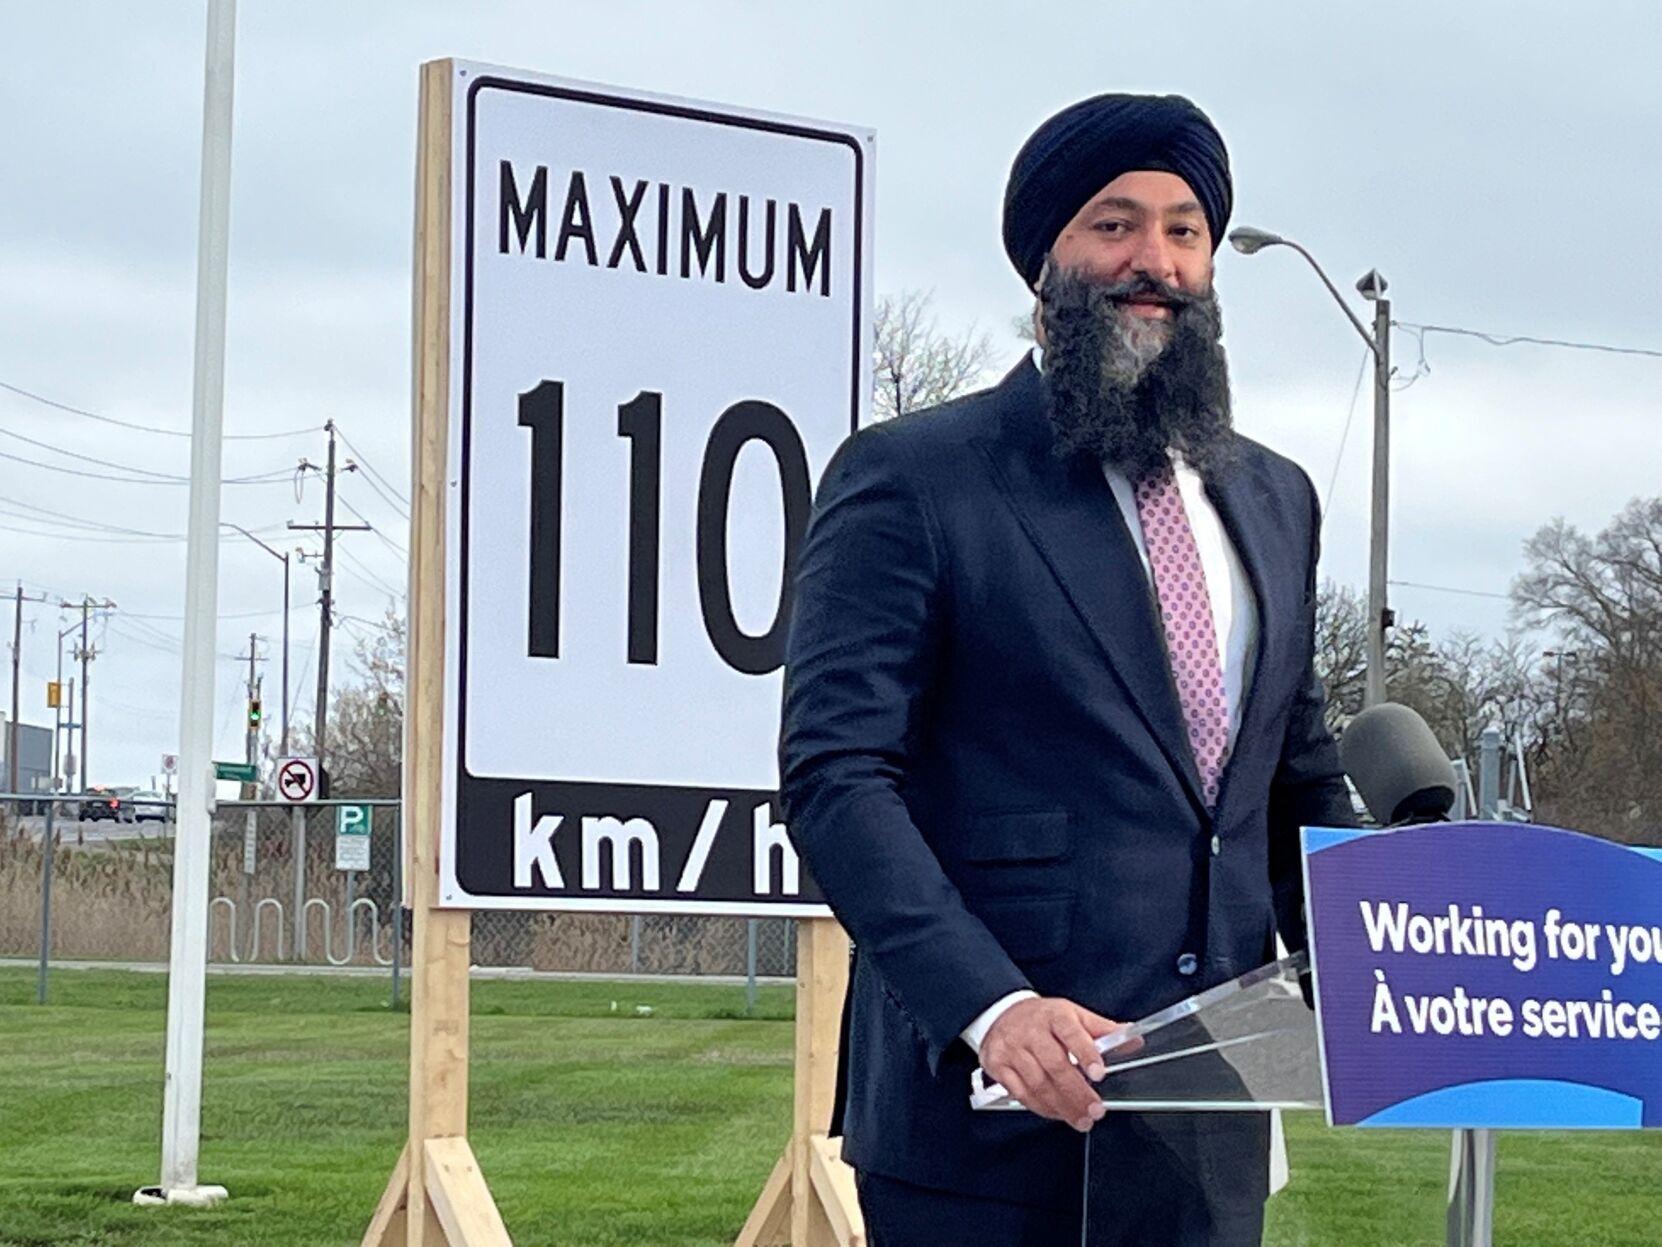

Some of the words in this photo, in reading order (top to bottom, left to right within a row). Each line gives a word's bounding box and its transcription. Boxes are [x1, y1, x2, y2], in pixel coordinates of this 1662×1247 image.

[499, 160, 832, 297] MAXIMUM
[518, 379, 812, 675] 110
[340, 807, 363, 834] P
[1360, 901, 1537, 972] Working
[1544, 909, 1602, 960] for
[1371, 969, 1402, 1033] À
[1405, 987, 1513, 1036] votre
[1521, 989, 1661, 1039] service
